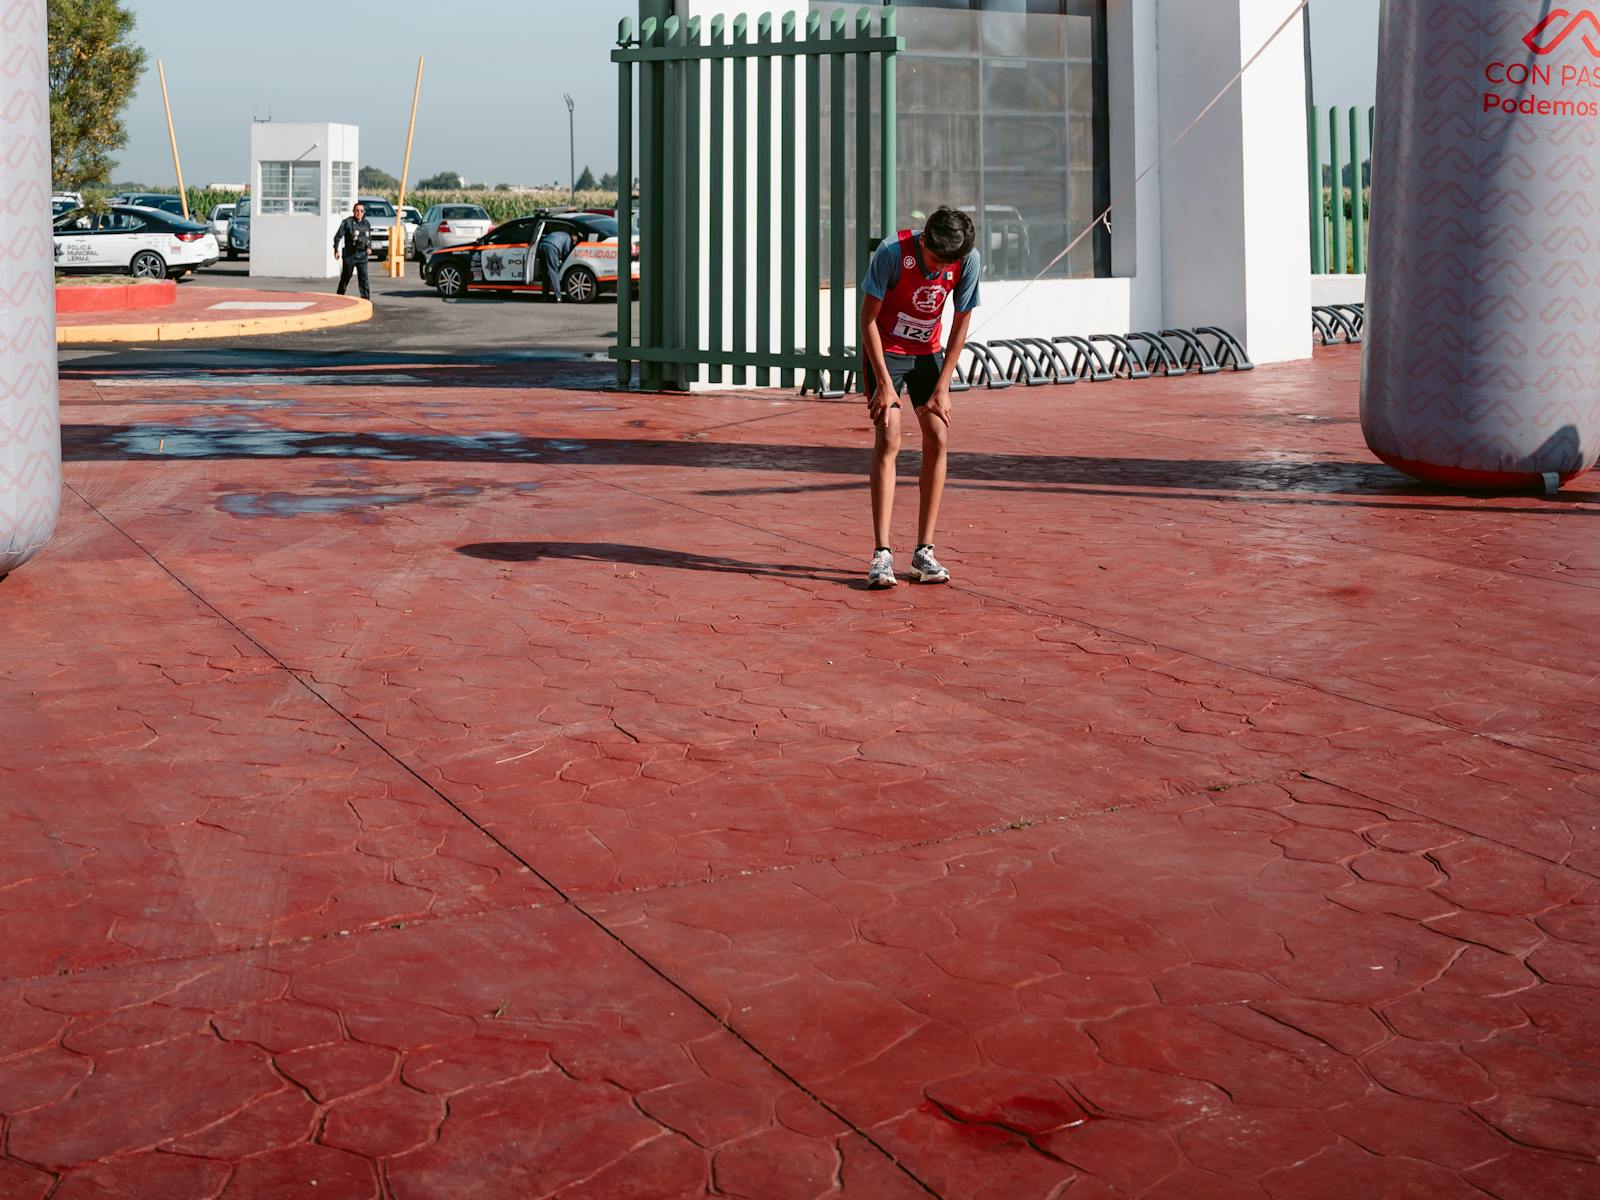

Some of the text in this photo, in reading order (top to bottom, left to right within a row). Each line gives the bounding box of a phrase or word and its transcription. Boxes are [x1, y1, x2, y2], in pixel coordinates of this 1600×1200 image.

[1484, 61, 1551, 86] CON
[1482, 92, 1598, 117] Podemos
[573, 249, 617, 260] VIALIDAD
